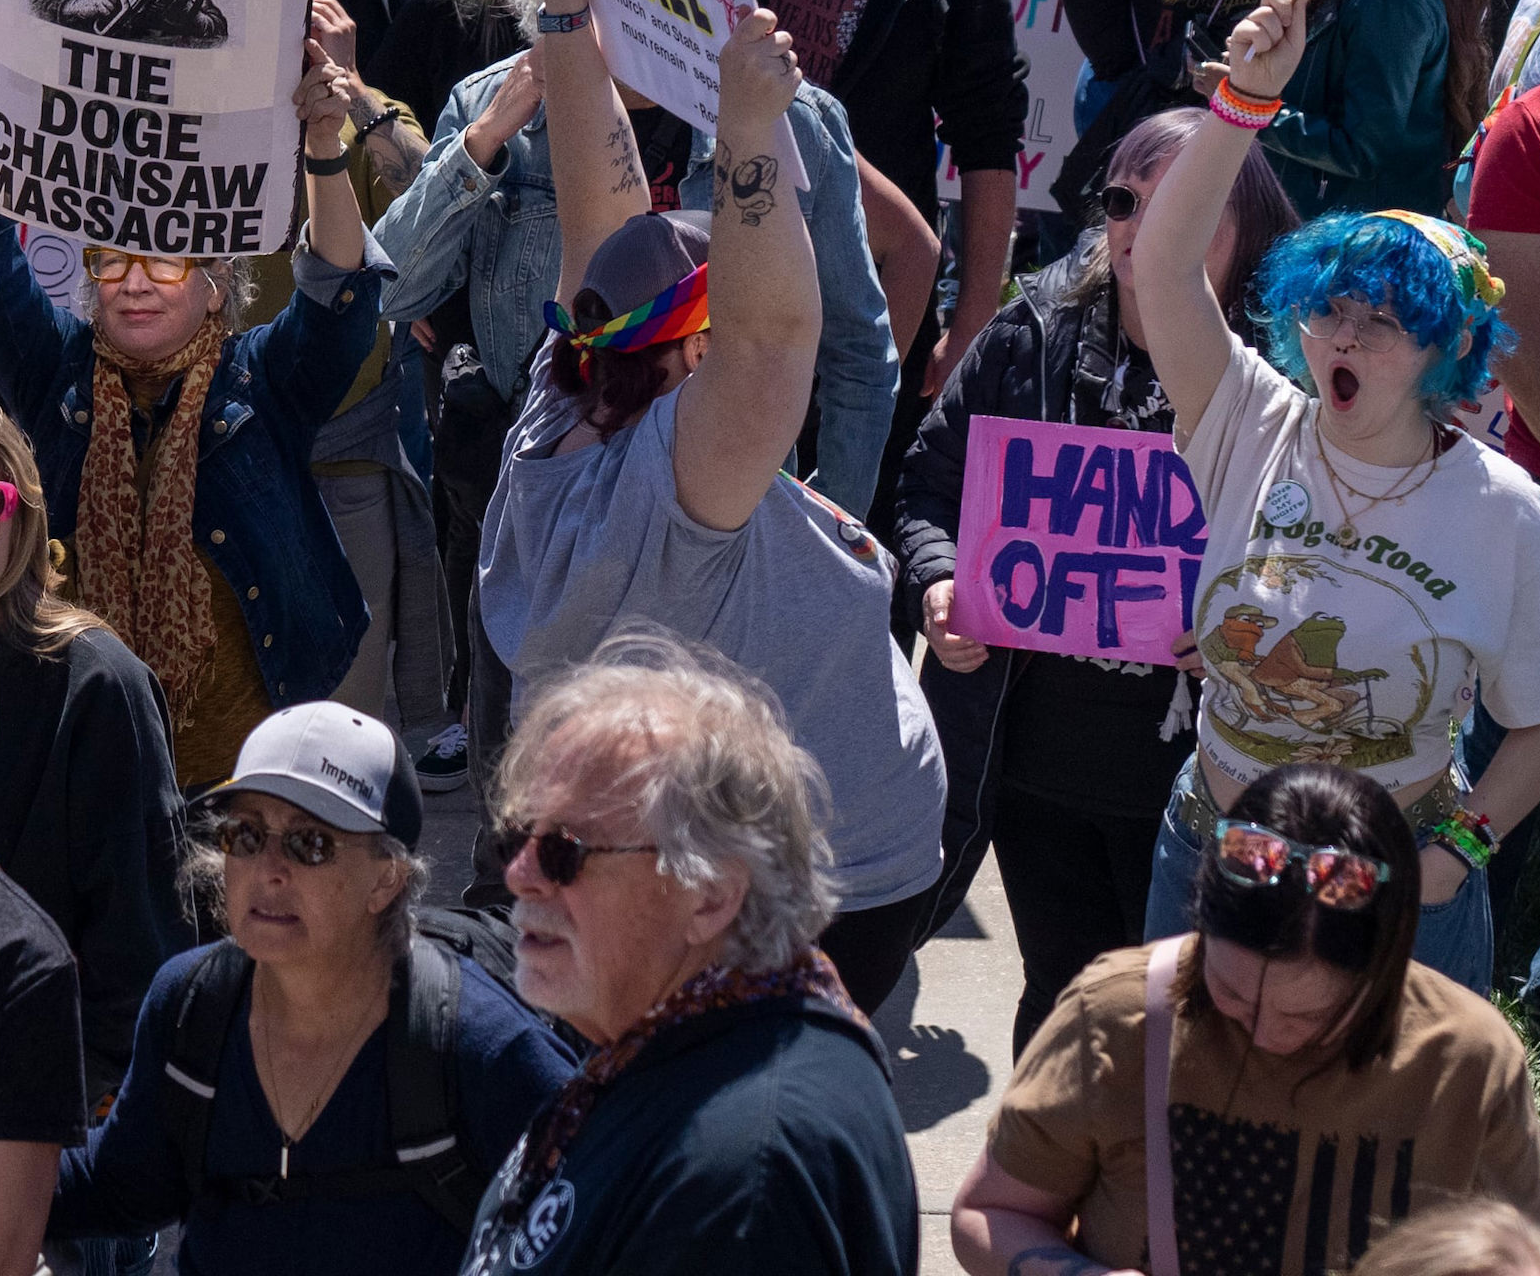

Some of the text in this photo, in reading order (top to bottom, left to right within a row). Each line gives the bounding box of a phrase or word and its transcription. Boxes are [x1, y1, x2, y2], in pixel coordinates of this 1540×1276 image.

[621, 20, 688, 75] must remain
[651, 12, 671, 36] and
[672, 22, 702, 57] State
[60, 38, 173, 105] THE
[38, 84, 203, 162] DOGE
[1364, 535, 1458, 602] Toad
[321, 757, 375, 801] Imperial
[1218, 760, 1235, 778] glad
